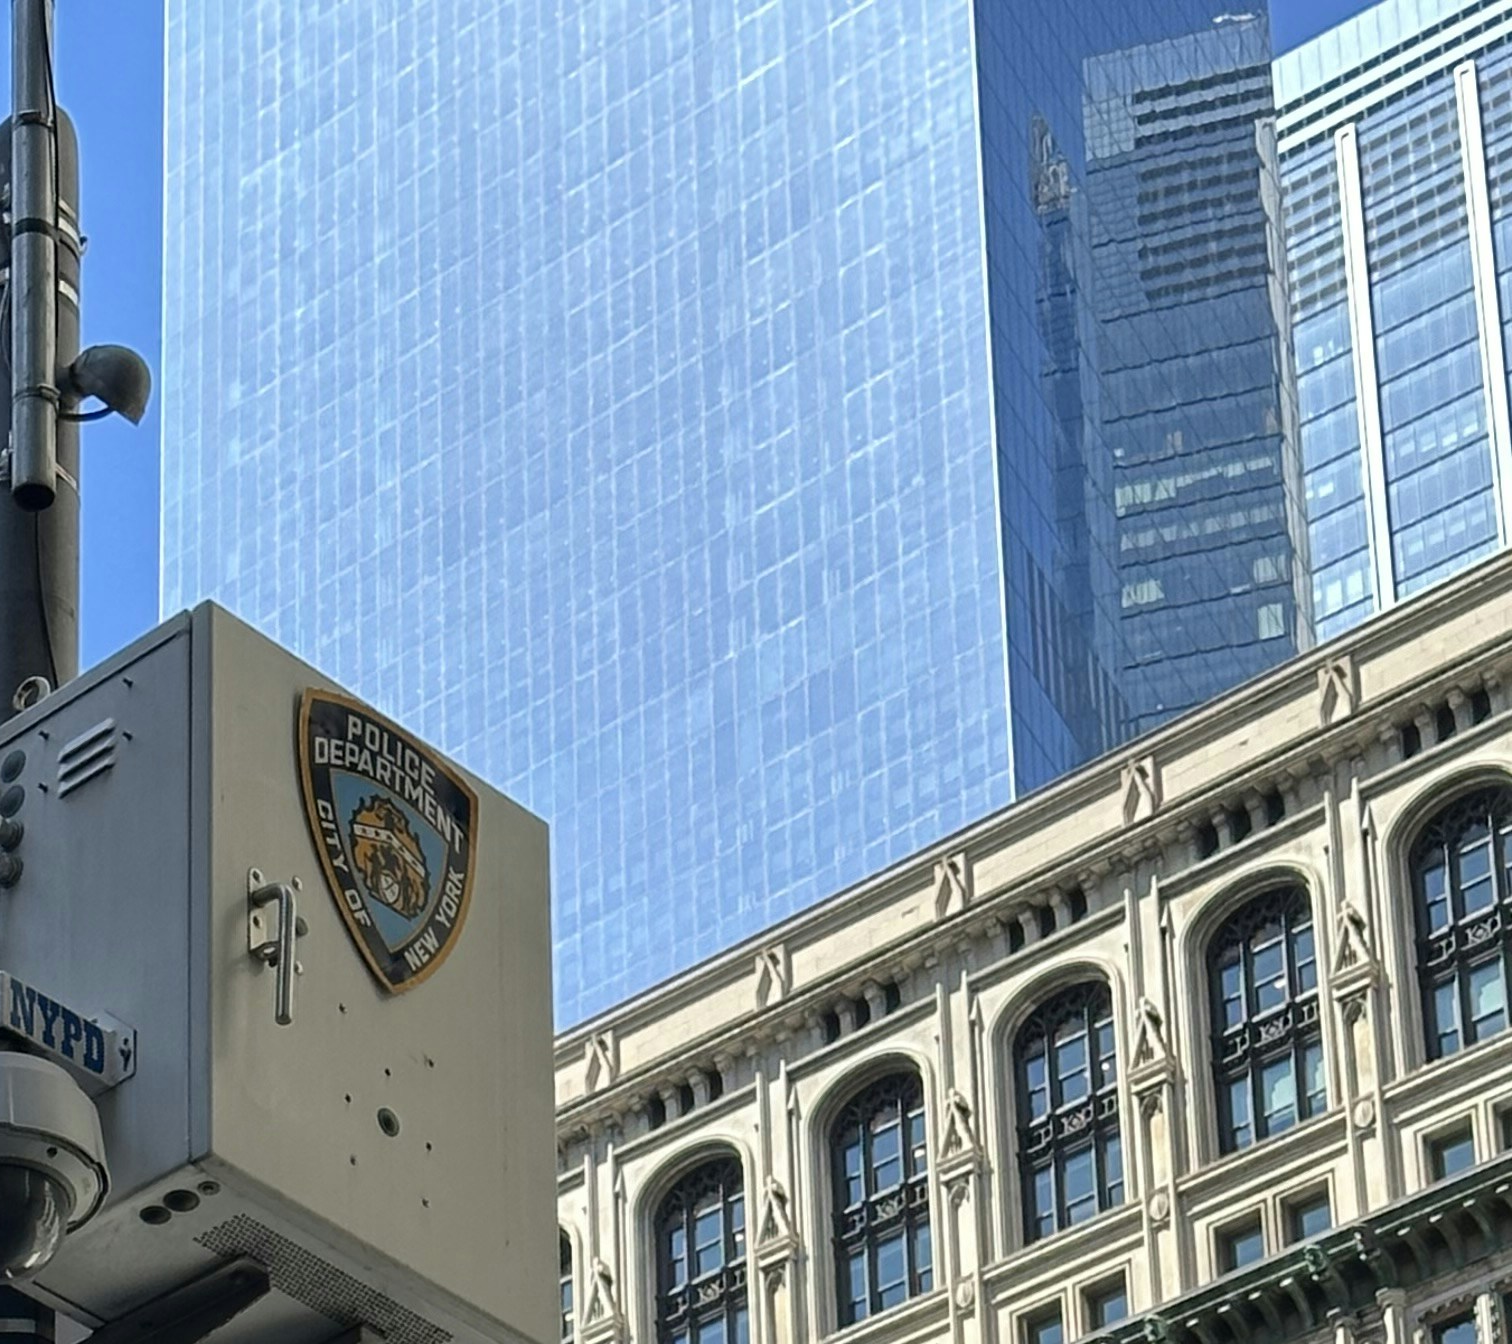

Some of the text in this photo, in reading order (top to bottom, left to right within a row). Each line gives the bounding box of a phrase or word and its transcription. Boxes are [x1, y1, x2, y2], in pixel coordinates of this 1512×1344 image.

[314, 736, 465, 854] DEPARTMENT
[346, 713, 436, 796] POLICE
[316, 798, 371, 928] CITY OF
[403, 866, 465, 972] NEW YORK
[10, 977, 105, 1075] NYPD
